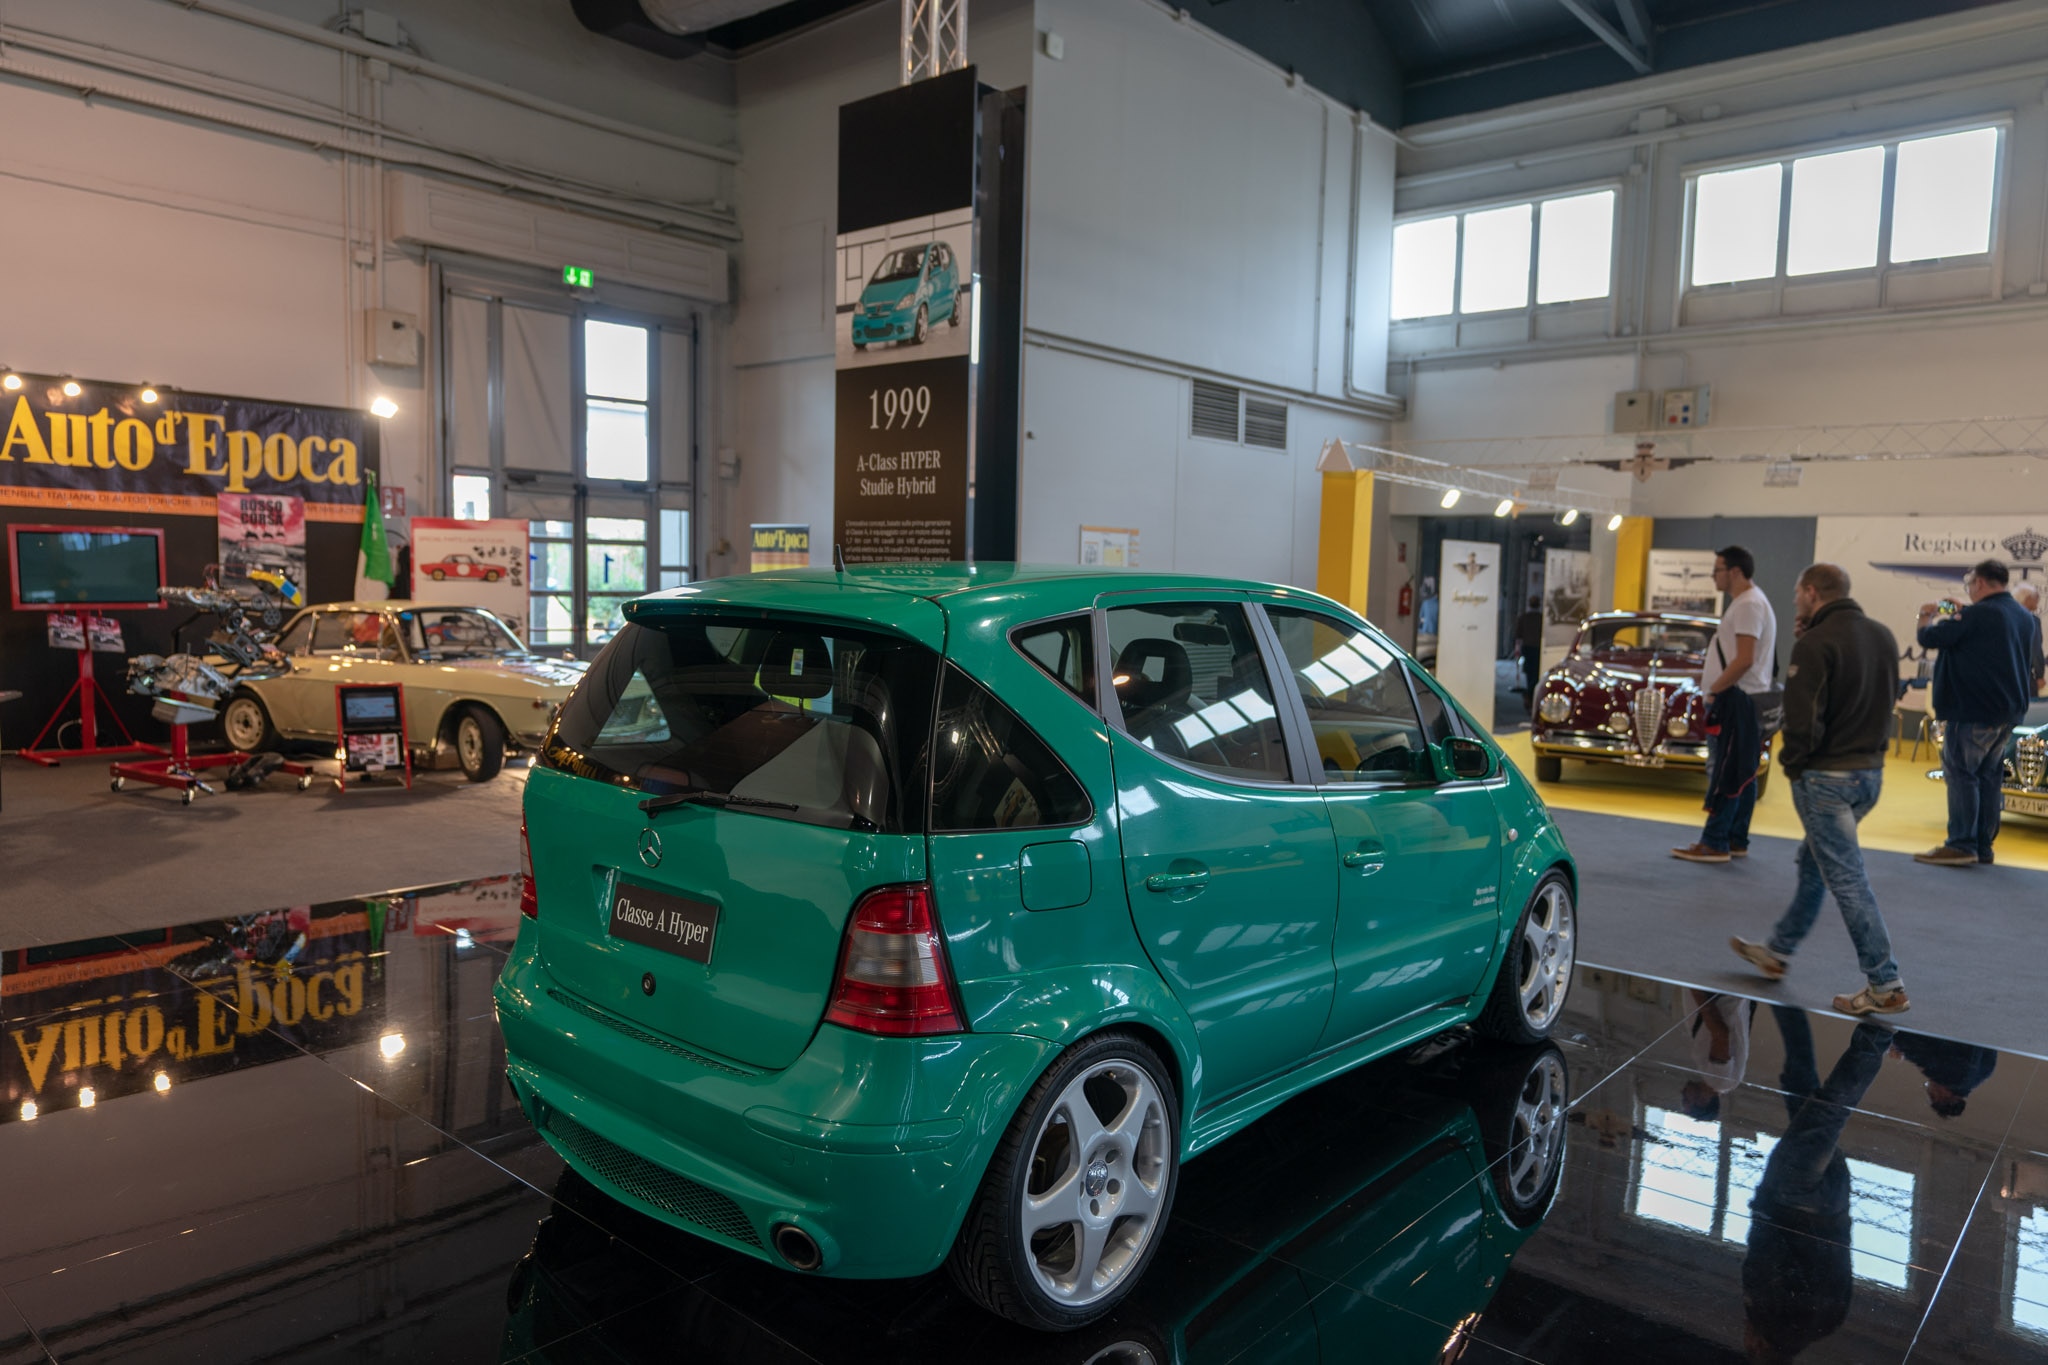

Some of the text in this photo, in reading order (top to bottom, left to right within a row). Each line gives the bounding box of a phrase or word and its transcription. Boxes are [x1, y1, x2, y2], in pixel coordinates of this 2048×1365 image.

[869, 386, 931, 430] 1999
[0, 395, 361, 493] Auto d'Epoca
[856, 450, 941, 472] A-Class HYPER
[0, 487, 43, 499] ENSILE
[860, 476, 936, 499] Studie Hybrid
[241, 499, 283, 513] ROSSO
[241, 512, 284, 526] CORSA
[1904, 532, 1996, 554] Registro
[616, 898, 709, 945] Classe A Hyper
